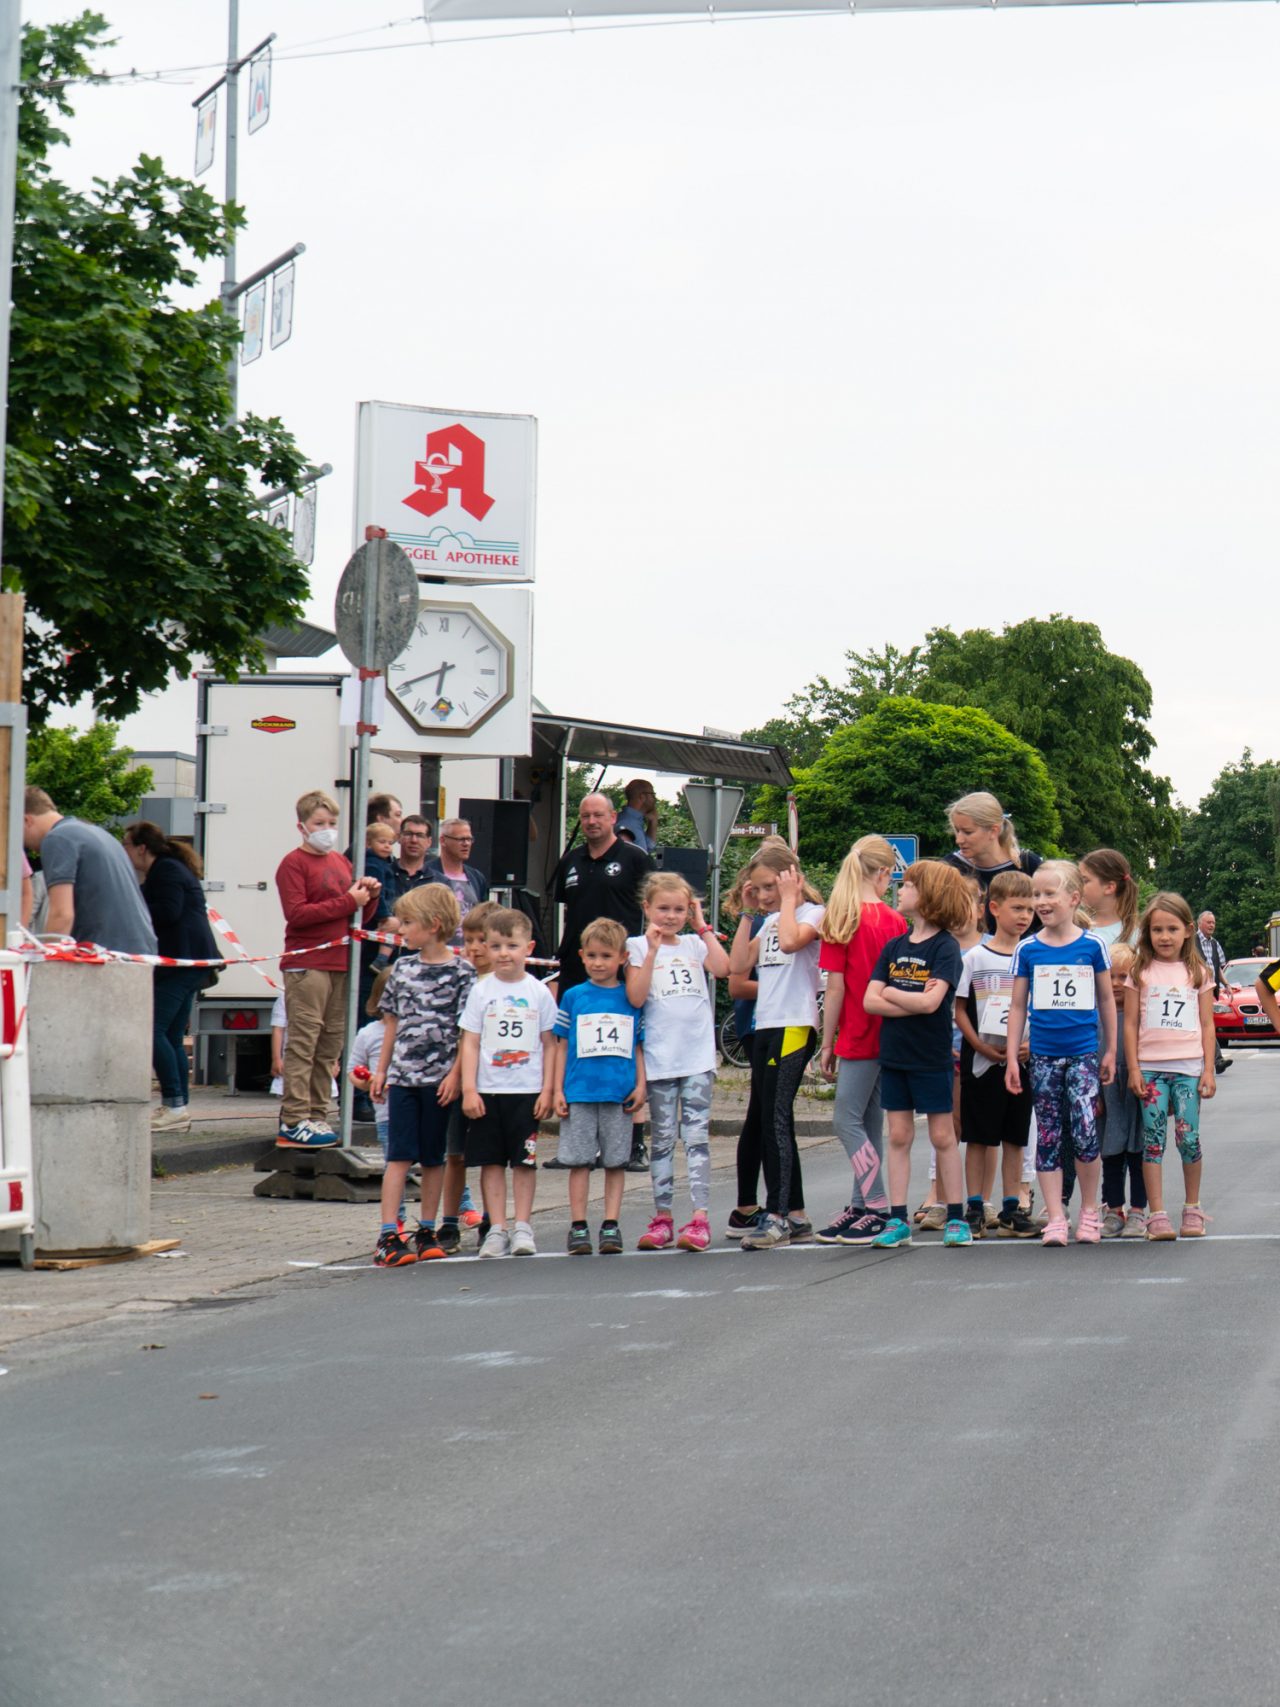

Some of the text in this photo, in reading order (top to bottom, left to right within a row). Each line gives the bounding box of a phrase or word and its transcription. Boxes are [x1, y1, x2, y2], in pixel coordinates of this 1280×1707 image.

[403, 547, 519, 566] GGEL APOTHEKE
[670, 969, 692, 985] 13
[1052, 979, 1077, 998] 16
[1051, 999, 1076, 1007] Marie
[1162, 999, 1186, 1018] 17
[497, 1020, 523, 1038] 35
[1160, 1018, 1183, 1028] Frida
[595, 1026, 619, 1044] 14
